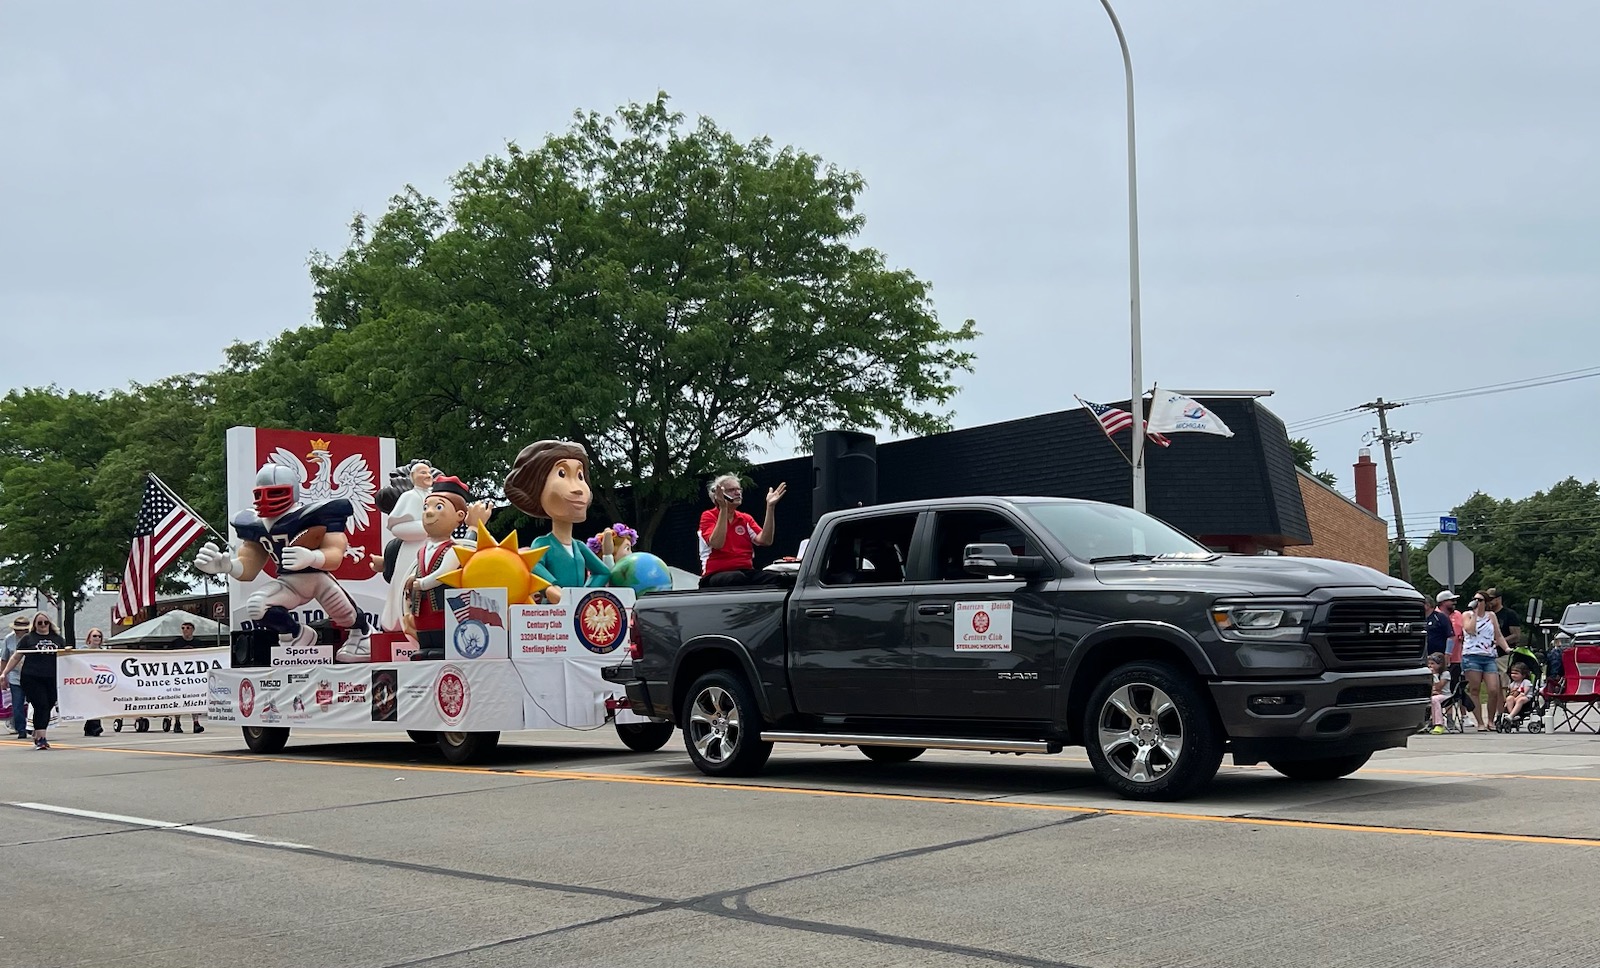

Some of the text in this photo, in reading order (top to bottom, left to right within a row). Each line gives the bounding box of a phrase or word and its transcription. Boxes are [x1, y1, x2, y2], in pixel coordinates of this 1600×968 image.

[1176, 422, 1207, 430] MICHIGAN
[991, 602, 1011, 611] Polish
[526, 621, 549, 630] Century
[1369, 622, 1411, 634] RAM
[538, 633, 555, 642] Maple
[556, 633, 569, 641] Lane
[963, 633, 1002, 641] Century Club
[285, 647, 319, 656] Sports
[522, 645, 567, 654] Sterling Heights
[272, 658, 332, 666] Gronkowski
[64, 674, 115, 686] PRCUA 150
[998, 672, 1038, 680] RAM
[137, 676, 208, 687] Dance Schoo
[182, 700, 207, 708] Michi
